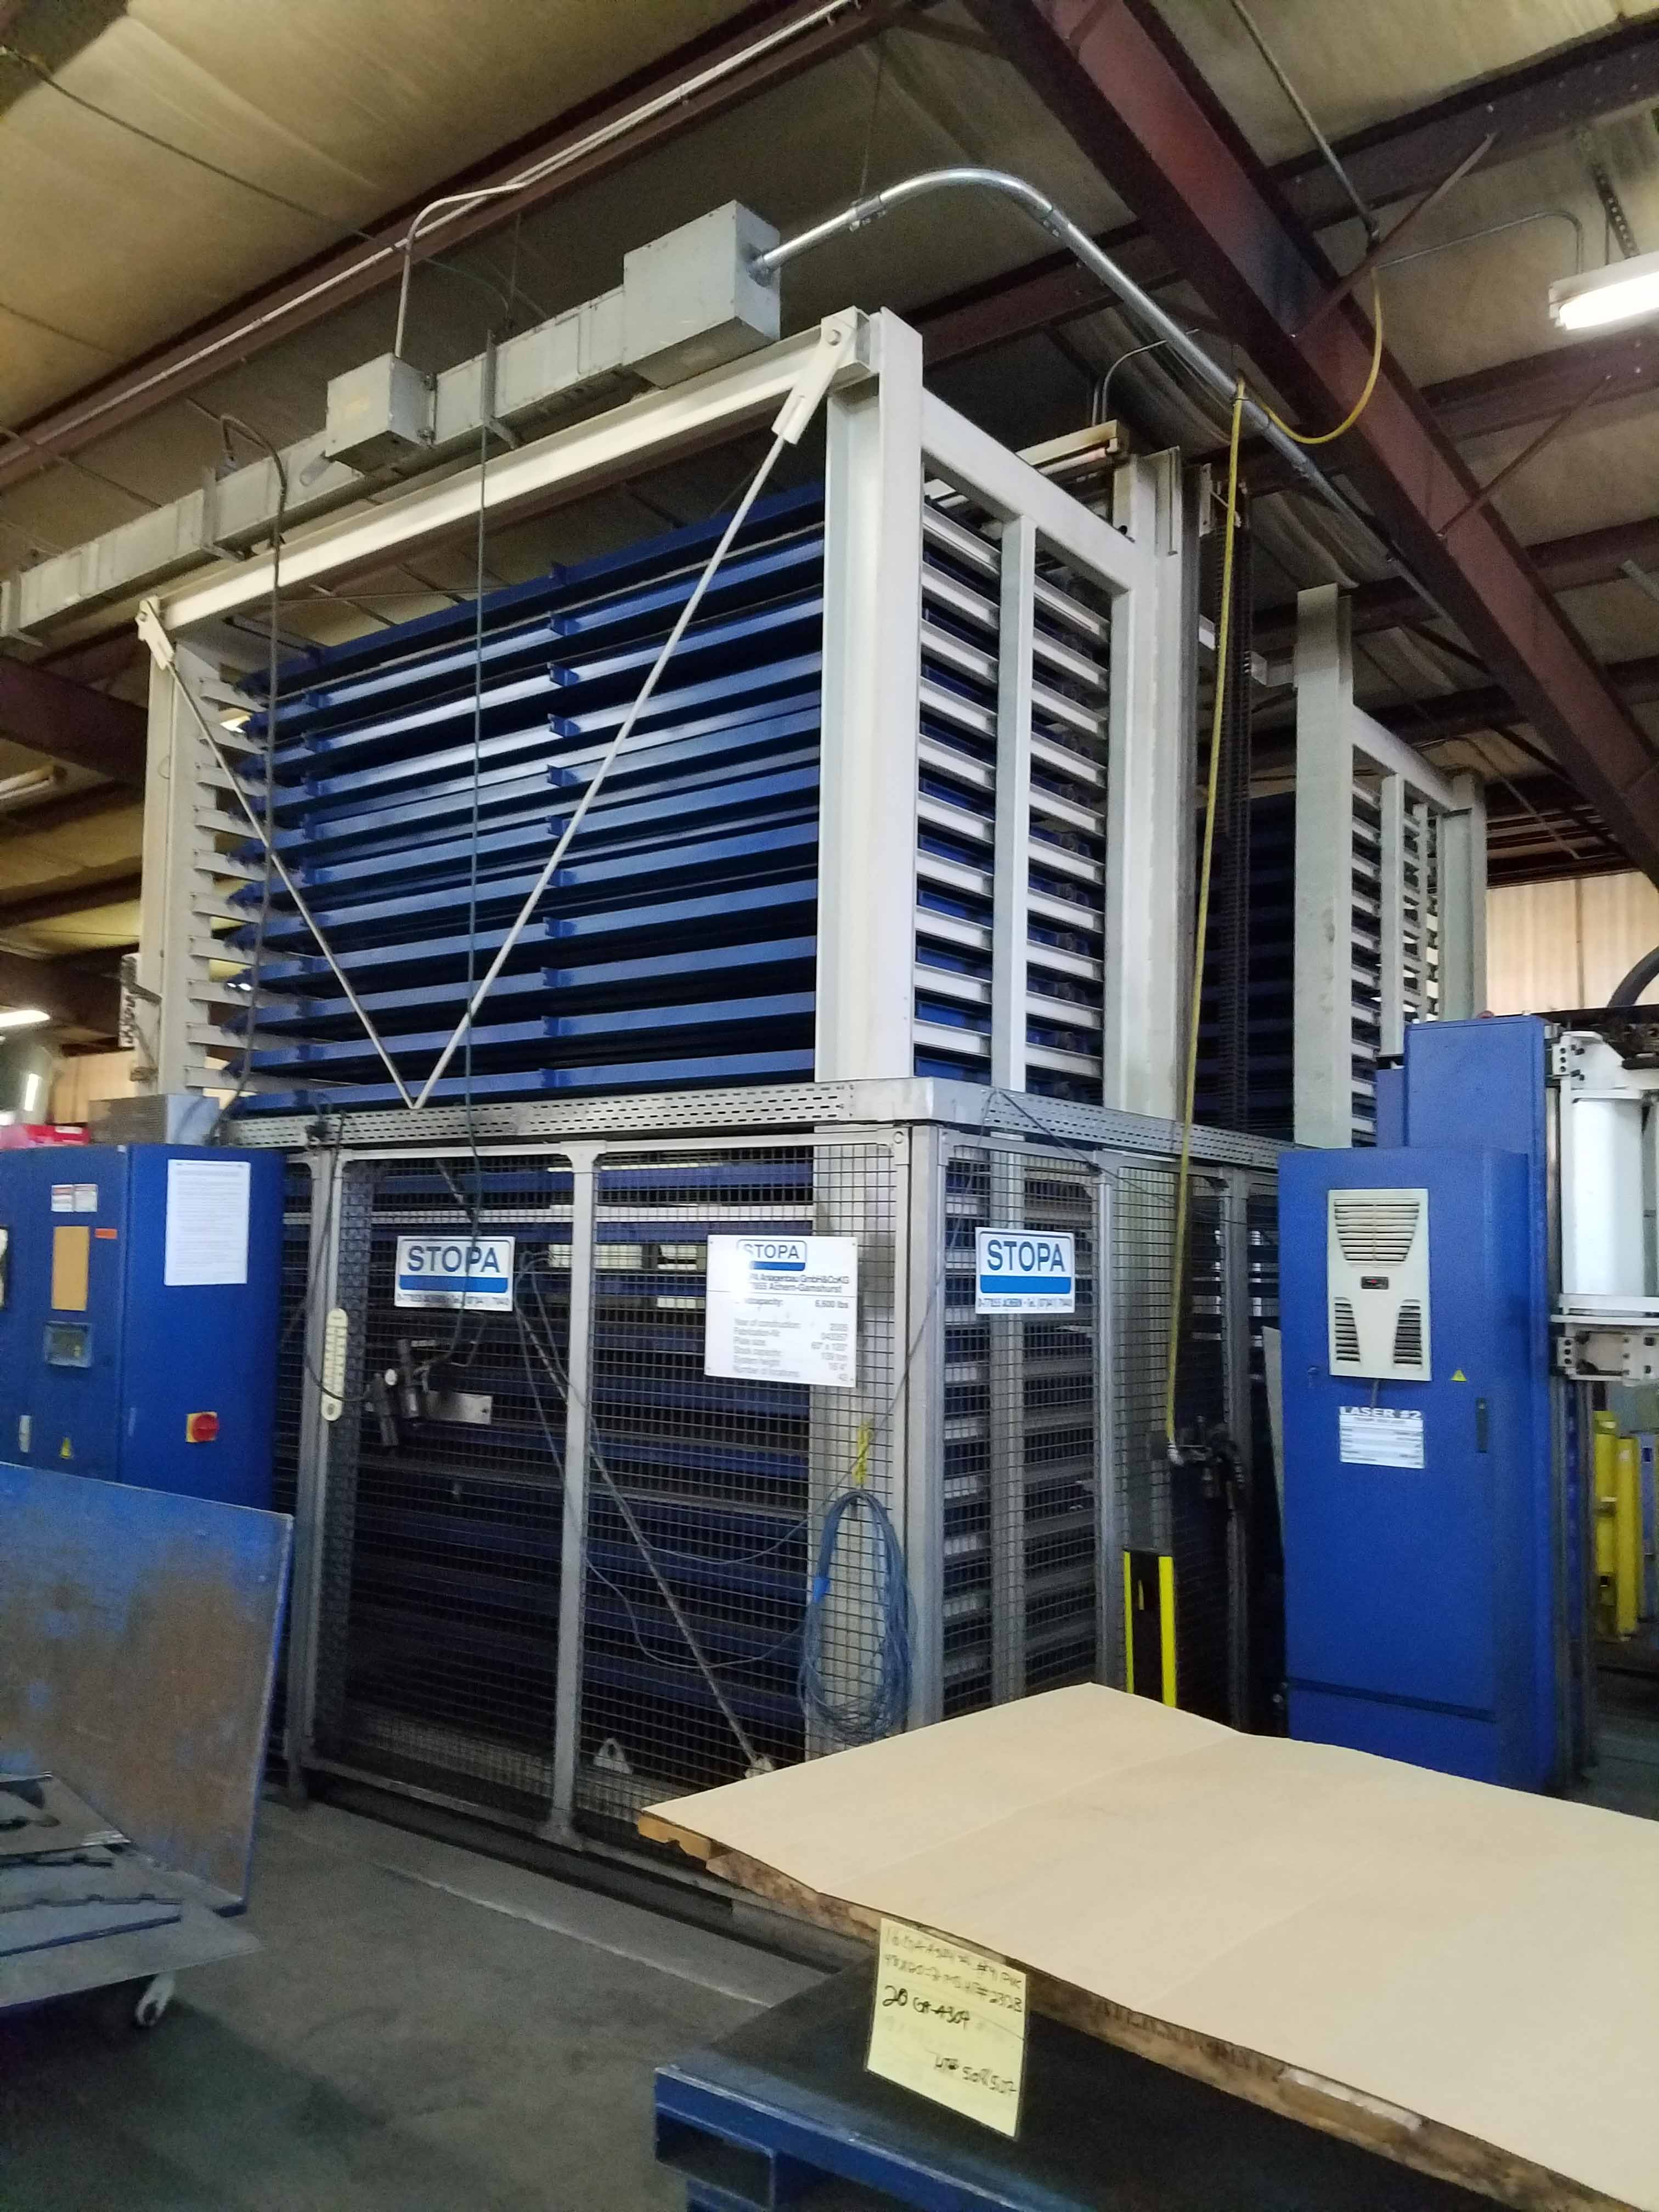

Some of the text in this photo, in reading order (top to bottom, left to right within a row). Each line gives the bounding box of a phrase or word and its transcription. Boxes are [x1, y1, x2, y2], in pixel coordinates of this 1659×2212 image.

[407, 1245, 500, 1273] STOPA
[743, 1244, 799, 1259] STOPA
[988, 1239, 1065, 1272] STOPA
[1341, 1406, 1422, 1420] LASER #2
